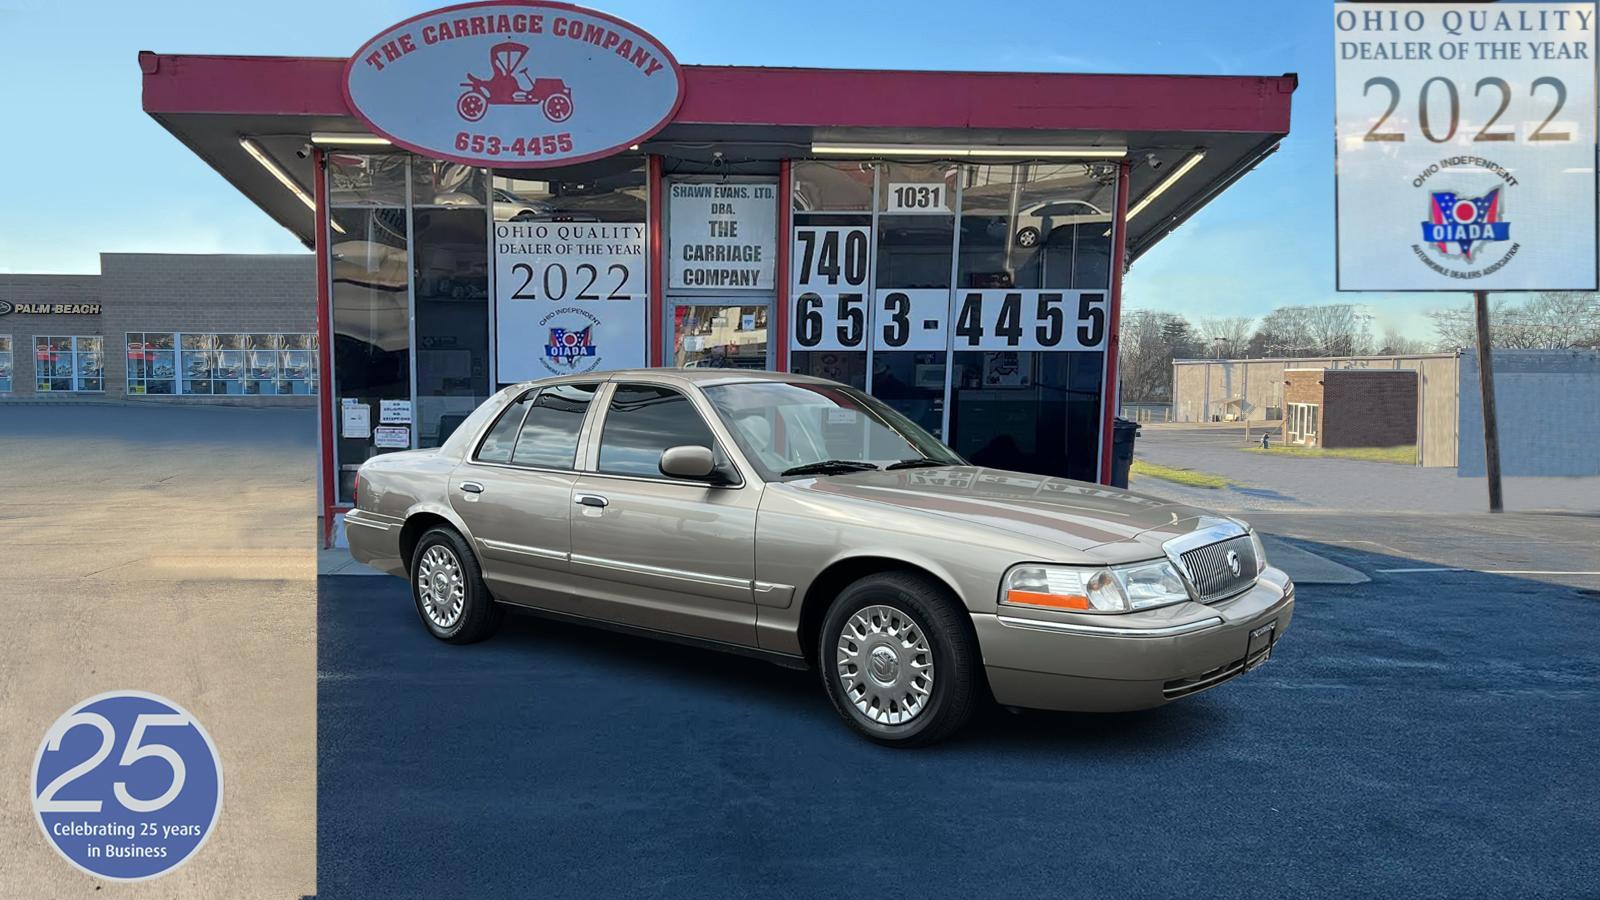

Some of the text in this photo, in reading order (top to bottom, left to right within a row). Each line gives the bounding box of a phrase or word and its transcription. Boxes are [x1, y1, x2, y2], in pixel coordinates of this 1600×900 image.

[1336, 10, 1593, 35] OHIO QUALITY
[366, 14, 664, 77] THE CARRIAGE COMPANY
[1340, 42, 1589, 60] DEALER OF THE YEAR
[1363, 76, 1571, 143] 2022
[455, 132, 573, 157] 653-4455
[1412, 156, 1519, 188] OHIO INDEPENDENT
[672, 186, 712, 199] SHAWN
[754, 187, 775, 200] LTD.
[894, 187, 940, 208] 1031
[711, 203, 736, 215] DBA.
[497, 226, 644, 242] OHIO QUALITY
[709, 220, 738, 238] THE
[1432, 224, 1495, 241] OIADA
[500, 243, 641, 256] DEALER OF THE YEAR
[683, 244, 762, 262] CARRIAGE
[797, 230, 868, 286] 740
[1411, 242, 1521, 279] AUTOMOBILE DEALERS ASSOCIATION
[511, 263, 631, 301] 2022
[683, 268, 760, 286] COMPANY
[14, 304, 100, 314] PALM BEACH
[539, 307, 601, 326] OHIO INDEPENDENT
[551, 347, 588, 356] OIADA
